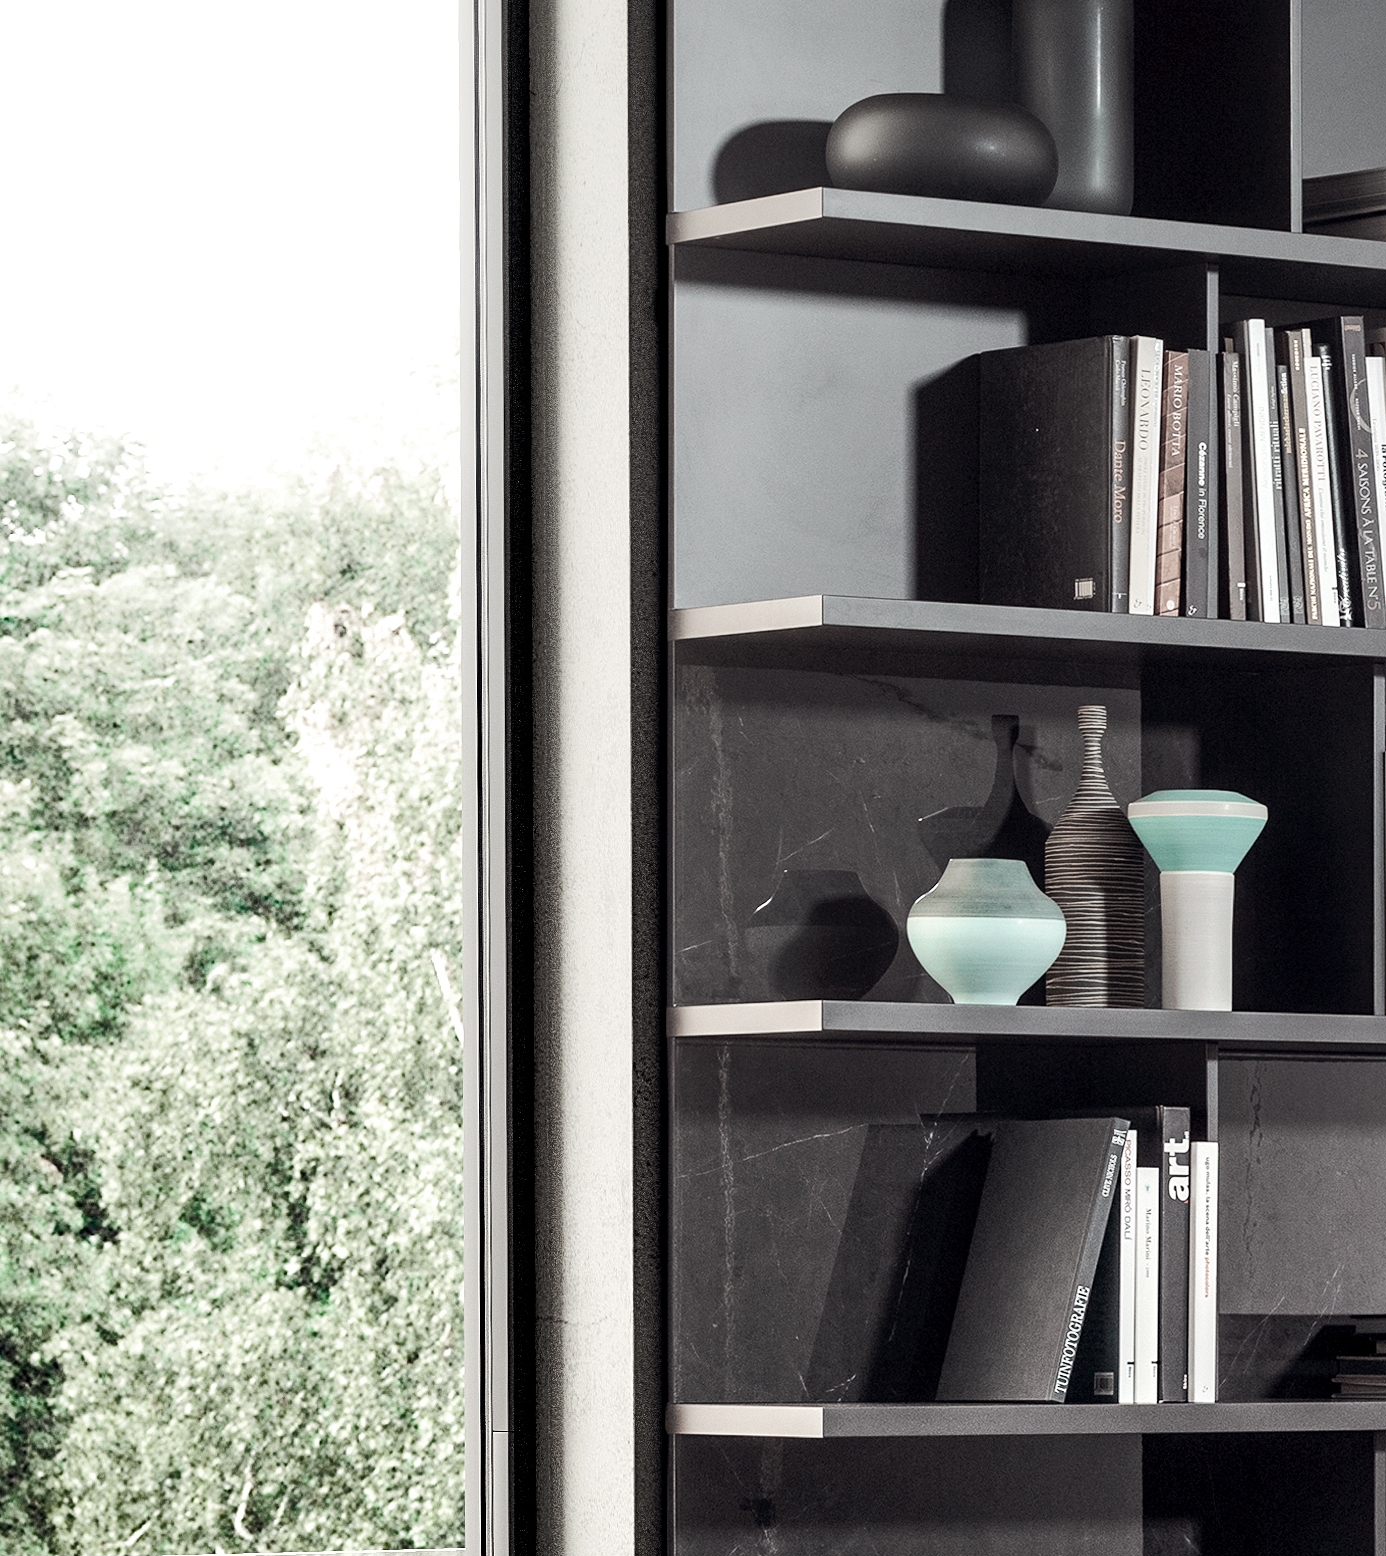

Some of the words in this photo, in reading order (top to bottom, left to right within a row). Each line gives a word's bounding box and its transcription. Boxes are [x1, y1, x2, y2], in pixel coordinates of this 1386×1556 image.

[1172, 364, 1185, 409] MARIO
[1309, 365, 1322, 417] LUCIANO
[1138, 369, 1152, 452] LEONARDO
[1231, 393, 1240, 427] Campigli
[1258, 405, 1266, 442] MENDINI
[1170, 411, 1182, 457] BOTTA
[1270, 420, 1280, 453] rituali
[1312, 419, 1325, 482] PAVAROTTI
[1113, 439, 1127, 482] Dante
[1197, 441, 1208, 487] Cézanne
[1273, 455, 1282, 490] ritratti
[1299, 427, 1310, 486] MERIDIONALE
[1355, 448, 1368, 460] 4
[1113, 484, 1127, 524] Moro
[1198, 487, 1207, 497] in
[1303, 487, 1312, 518] AFRICA
[1356, 462, 1372, 515] SAISONS
[1197, 498, 1207, 540] Florence
[1305, 519, 1313, 545] MONDO
[1361, 516, 1375, 528] À
[1362, 529, 1374, 546] LA
[1363, 548, 1378, 583] TABLE
[1123, 1139, 1132, 1186] PICASSO
[1124, 1188, 1132, 1213] MIRÓ
[1124, 1215, 1133, 1241] DALÍ
[1054, 1285, 1090, 1394] TUINFOTOGRAFIE
